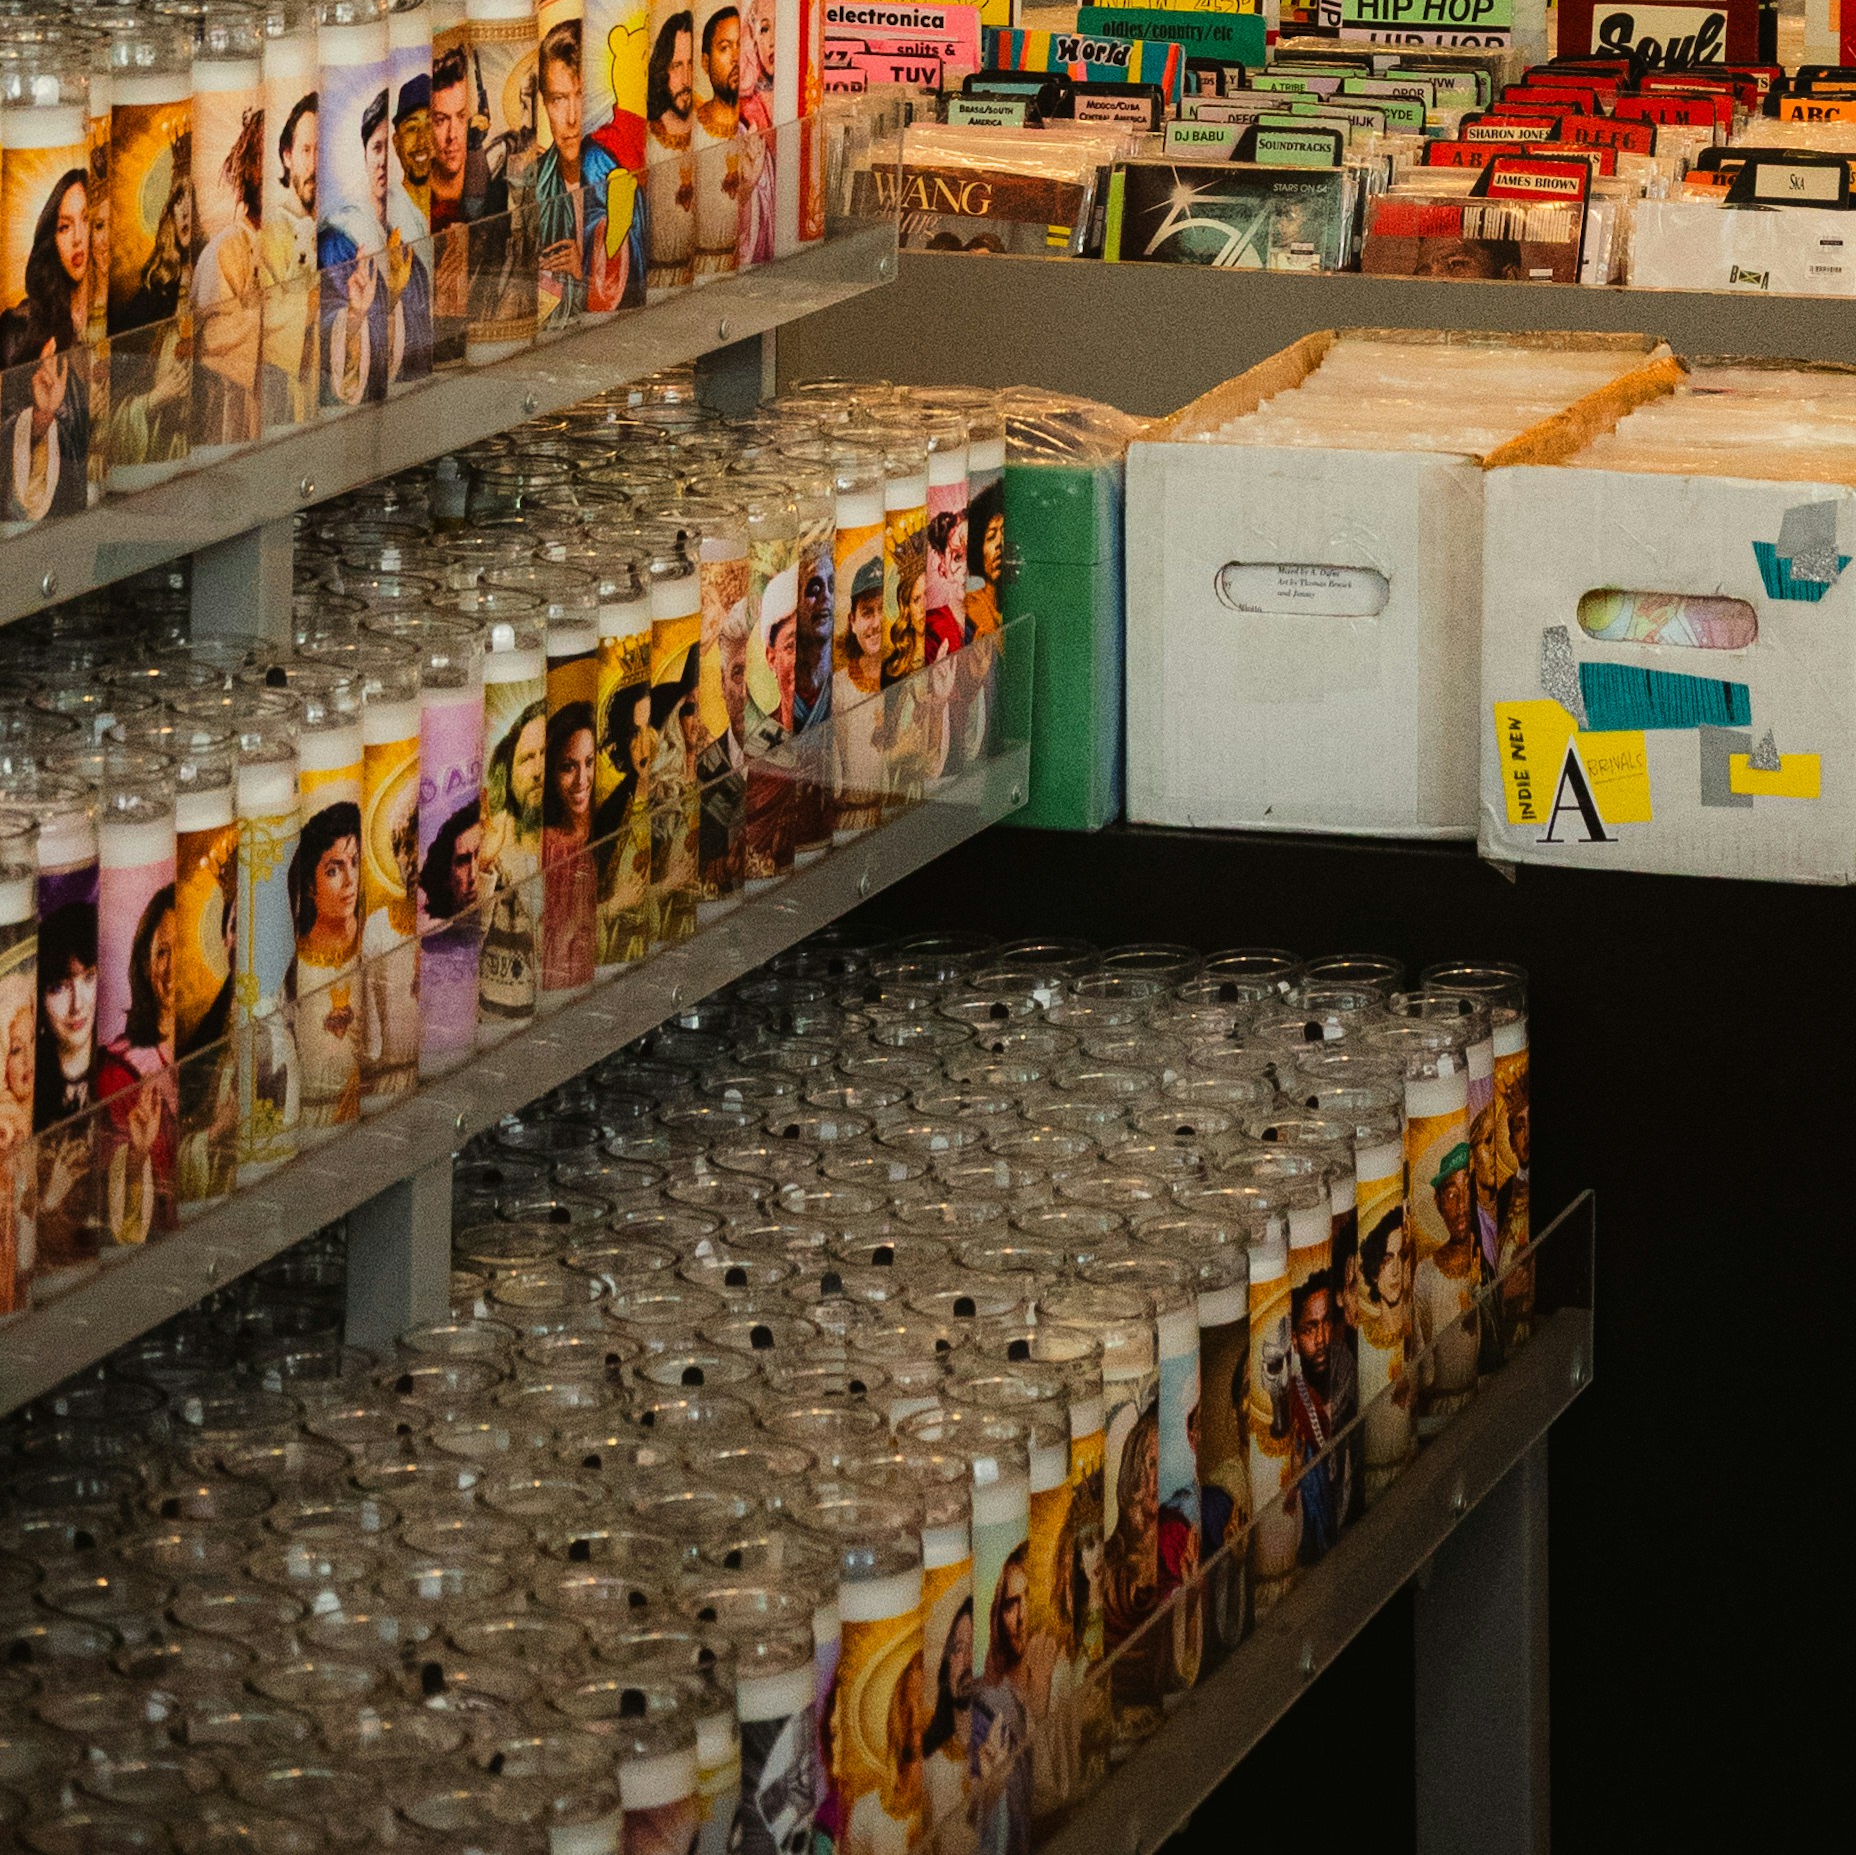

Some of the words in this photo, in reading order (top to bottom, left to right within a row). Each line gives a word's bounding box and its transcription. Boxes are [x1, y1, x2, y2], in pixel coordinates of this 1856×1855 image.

[827, 5, 945, 29] electronica
[1102, 21, 1233, 45] oldies/country/etc
[1597, 12, 1728, 70] Soul
[1057, 36, 1133, 69] World
[890, 66, 936, 84] TUV
[1791, 105, 1841, 121] ABC
[1469, 127, 1514, 139] SHARON
[1516, 127, 1551, 140] JONES
[1258, 139, 1332, 153] SOUNDTRACKS
[875, 172, 992, 215] WANG
[1494, 174, 1532, 188] JAMES
[1535, 176, 1578, 190] BROWN
[1507, 716, 1527, 762] NEW
[1521, 768, 1538, 822] INDIE
